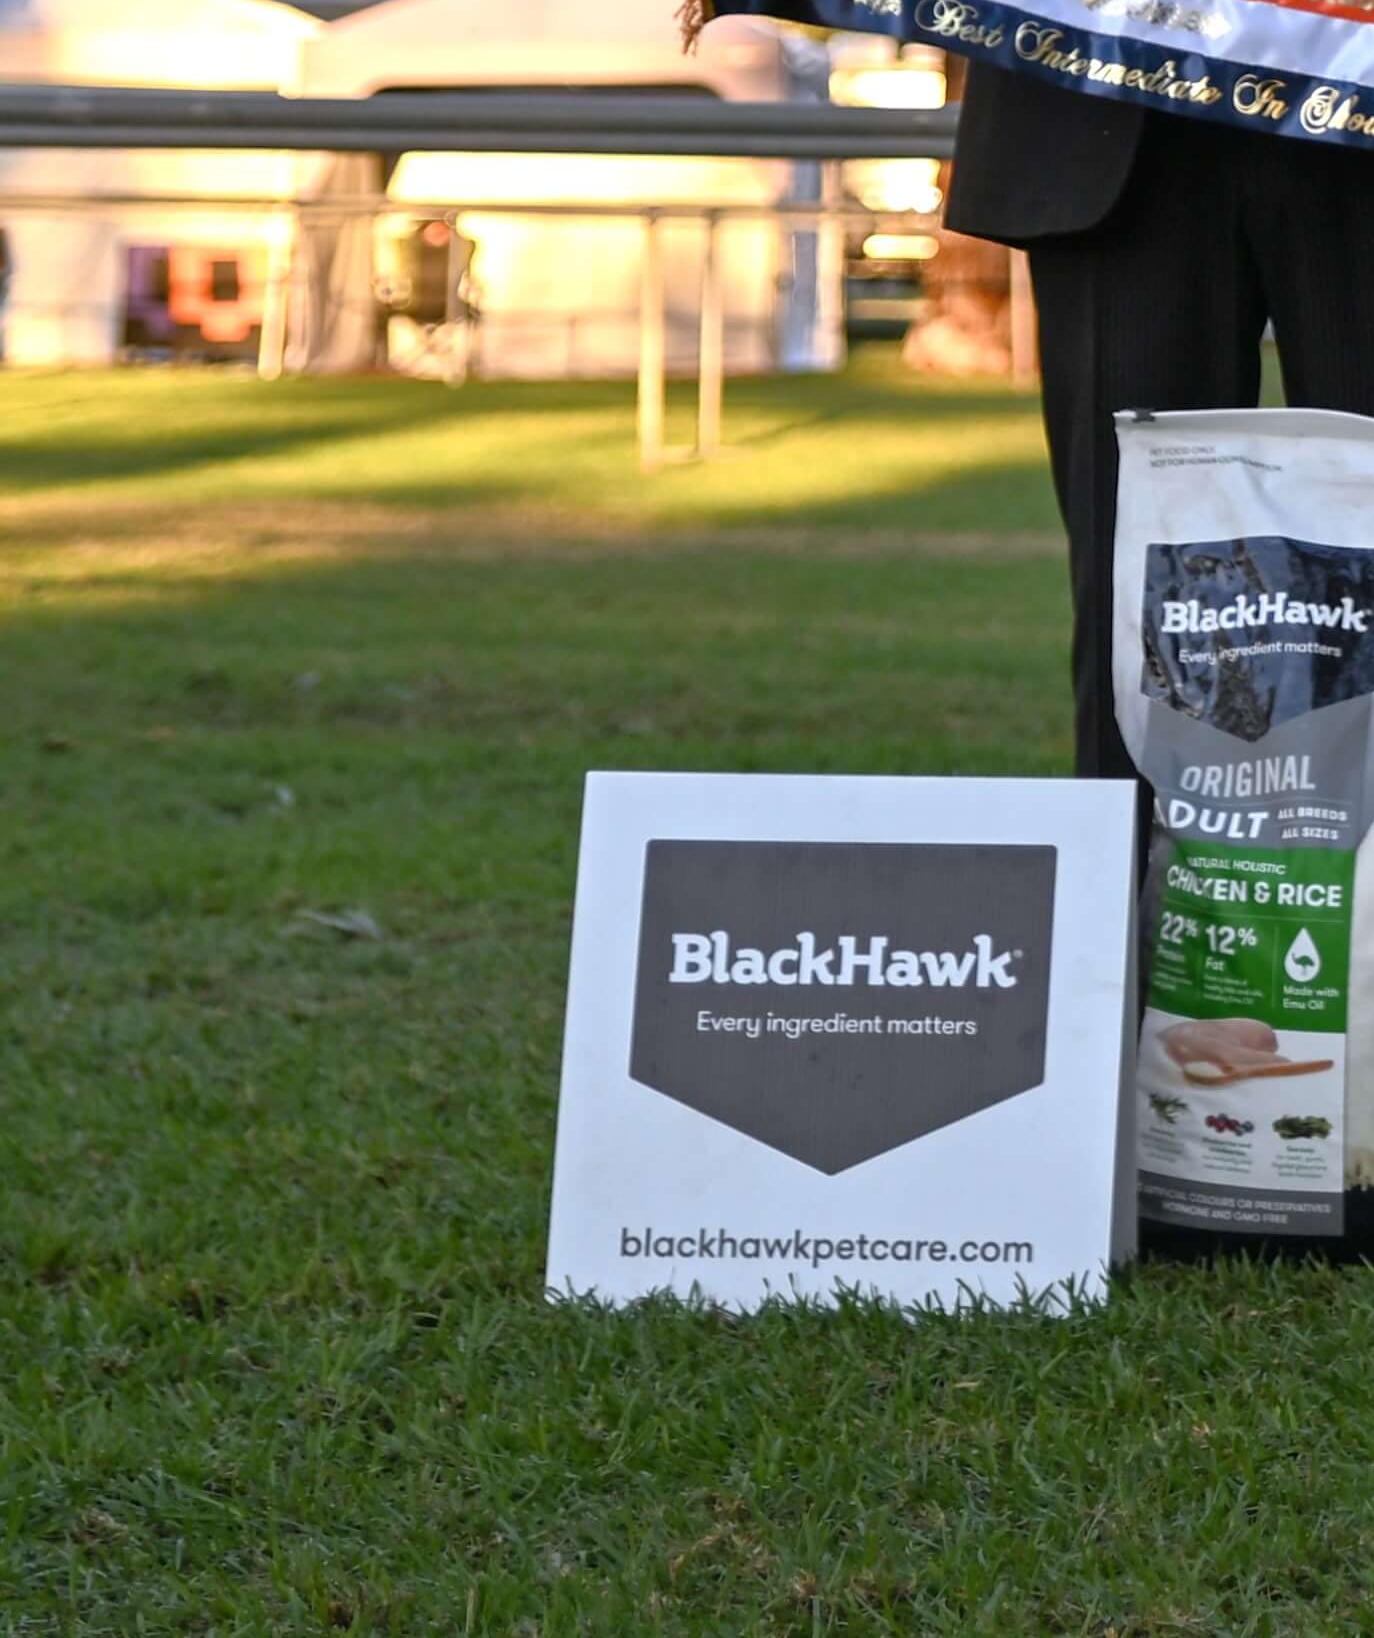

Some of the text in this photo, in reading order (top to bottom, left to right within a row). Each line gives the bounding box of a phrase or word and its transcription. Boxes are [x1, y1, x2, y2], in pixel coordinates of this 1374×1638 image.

[1014, 20, 1224, 106] Intermediate
[1232, 73, 1290, 121] In
[1161, 592, 1369, 633] BlackHawk
[1178, 641, 1343, 665] Every ingredient matters
[1179, 755, 1316, 798] ORIGINAL
[1278, 806, 1348, 822] ALL BREEDS
[1281, 826, 1340, 841] ALL SIZES
[1254, 881, 1271, 904] &
[1277, 883, 1342, 908] RICE
[1159, 911, 1198, 945] 22%
[1205, 924, 1258, 955] 12%
[668, 930, 1017, 989] BlackHawk
[1205, 956, 1225, 972] Fat
[1282, 998, 1306, 1010] Emu
[1283, 985, 1340, 998] Made with
[696, 1011, 977, 1038] Every ingredient matters
[620, 1228, 1034, 1268] blackhawkpetcare.com
